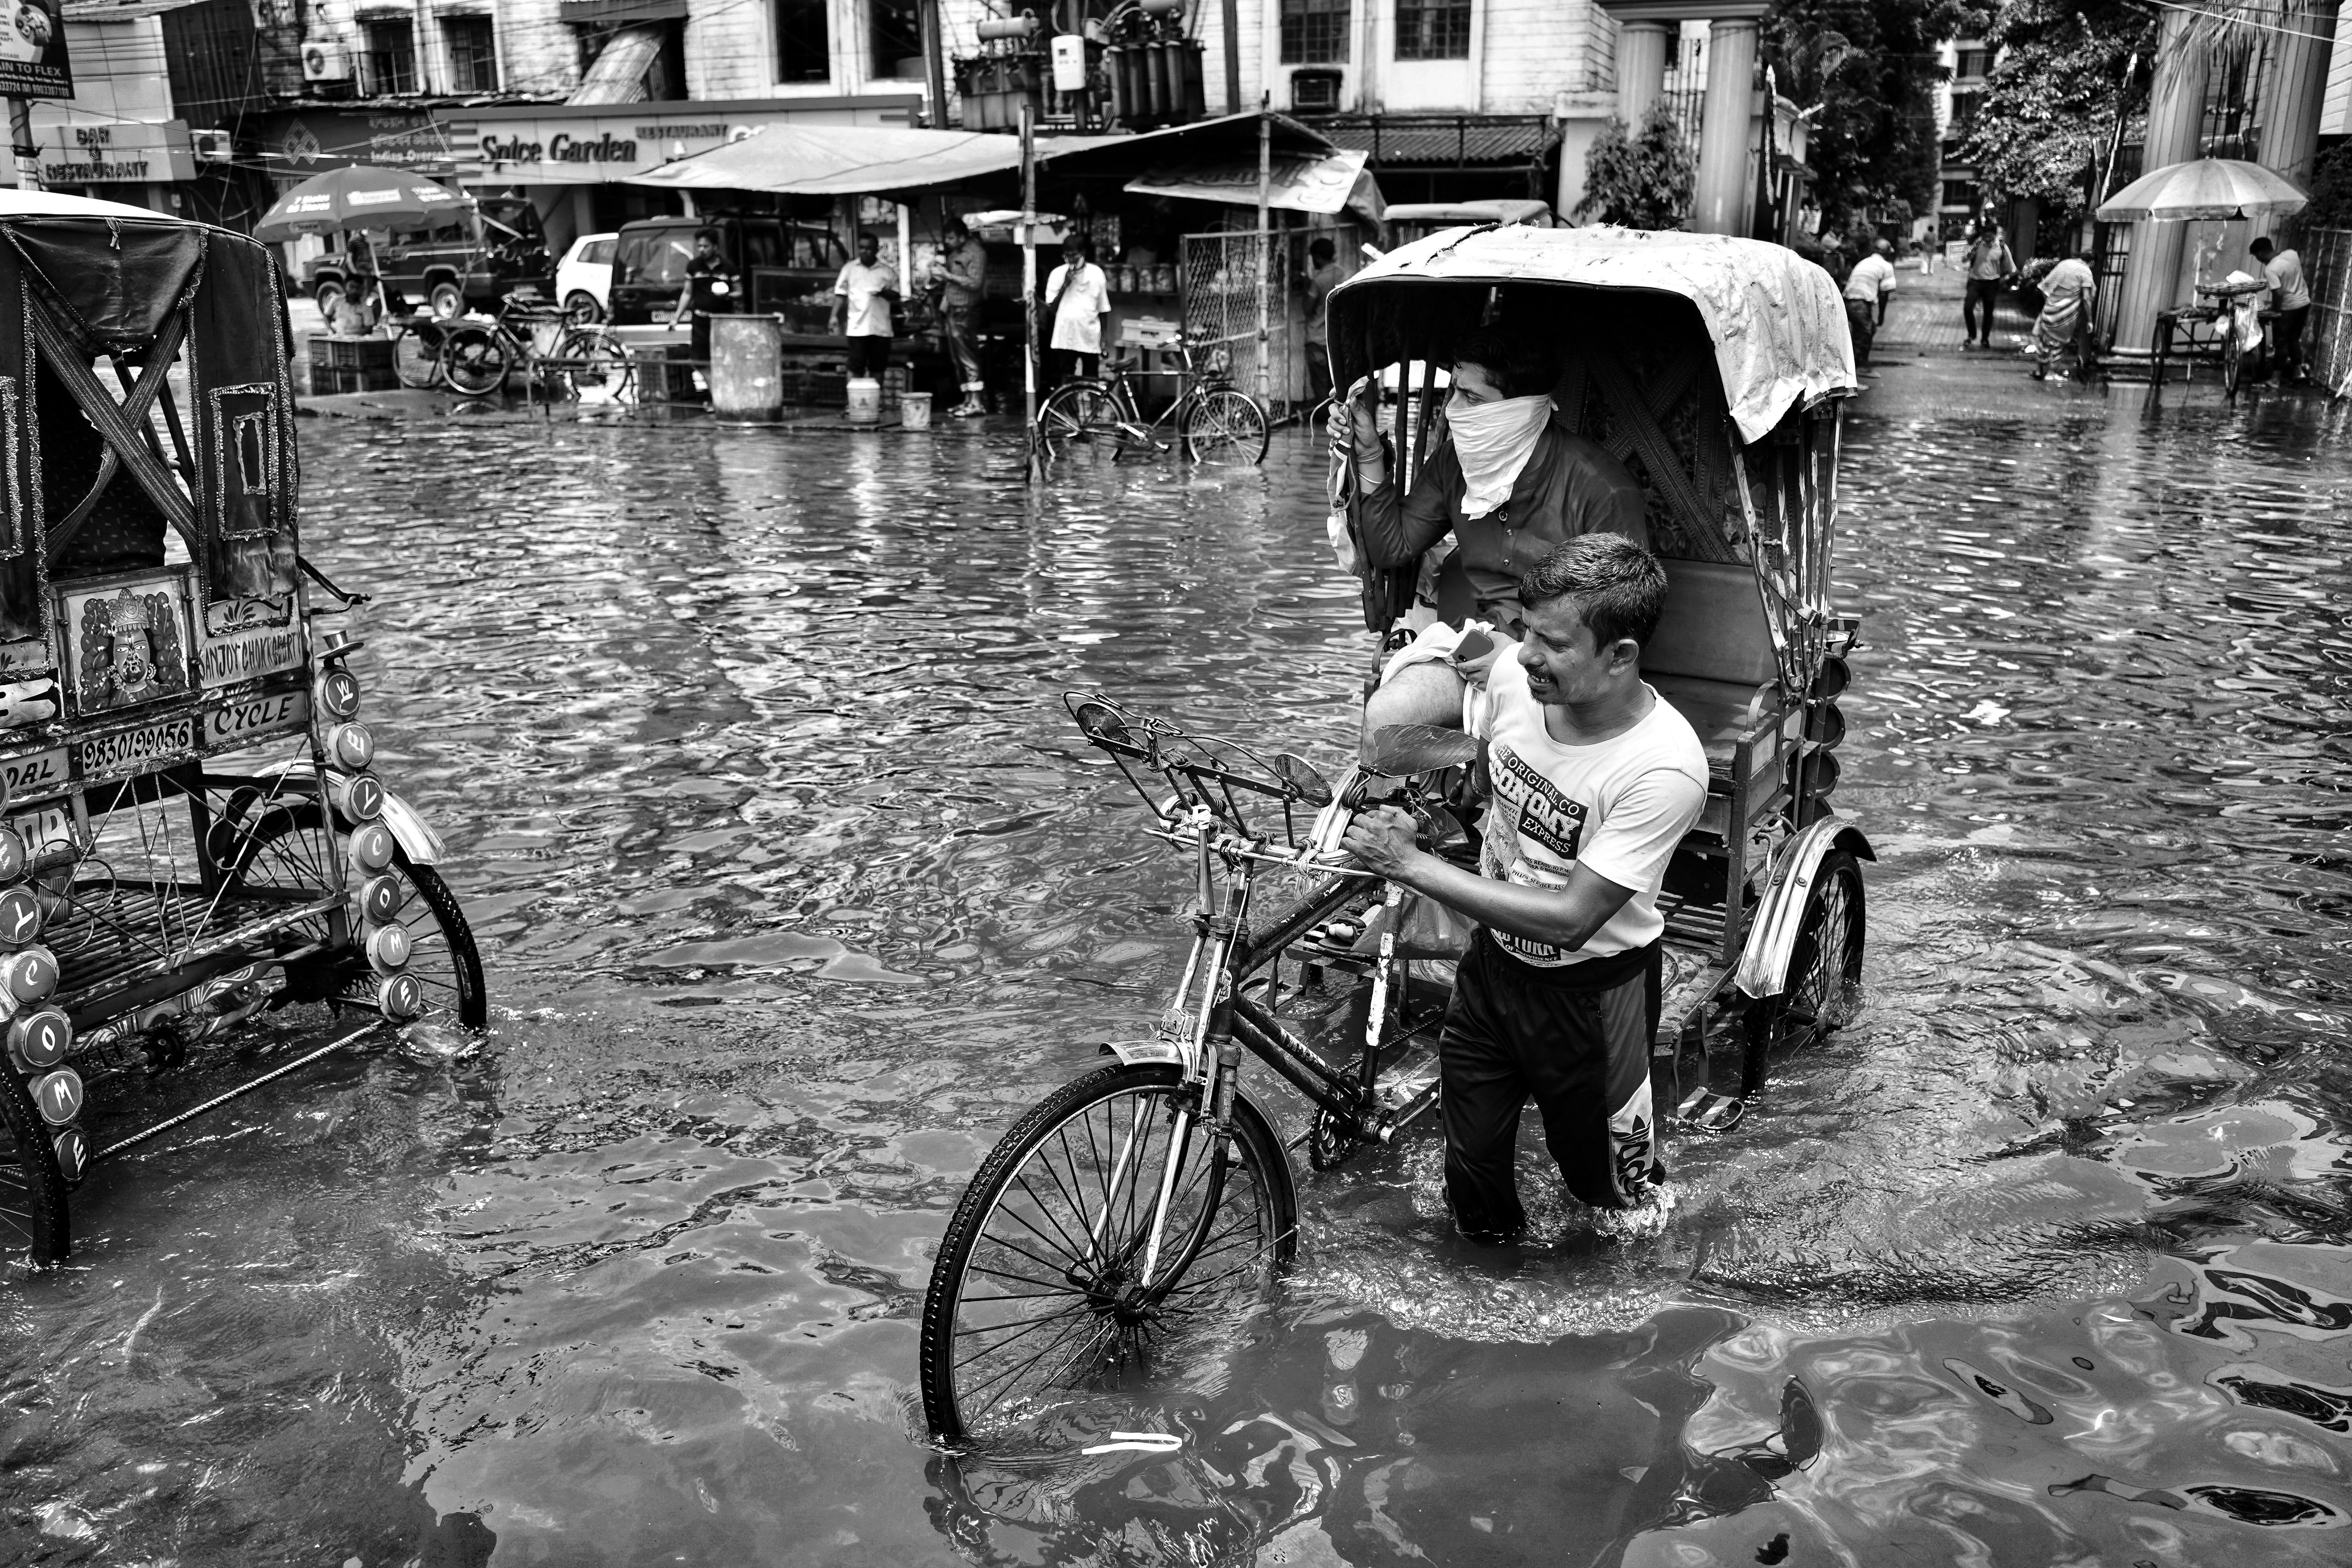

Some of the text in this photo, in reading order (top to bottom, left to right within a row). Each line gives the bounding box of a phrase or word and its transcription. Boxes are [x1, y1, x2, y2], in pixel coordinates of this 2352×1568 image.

[16, 63, 32, 74] TO
[35, 65, 62, 77] FLEX
[76, 127, 108, 144] BAR
[89, 145, 101, 161] &
[480, 135, 541, 173] Spice
[550, 133, 636, 162] Garden
[46, 161, 148, 180] RESTAURANT
[199, 642, 239, 681] SANJOY
[214, 696, 296, 736] CYCLE
[84, 721, 189, 770] 9830199056
[1522, 817, 1571, 853] EXPRESS
[1512, 870, 1530, 880] PILLOW
[1530, 878, 1551, 889] SERVICE
[1545, 868, 1566, 877] BOSTON
[1516, 949, 1558, 961] PROVIDENCE
